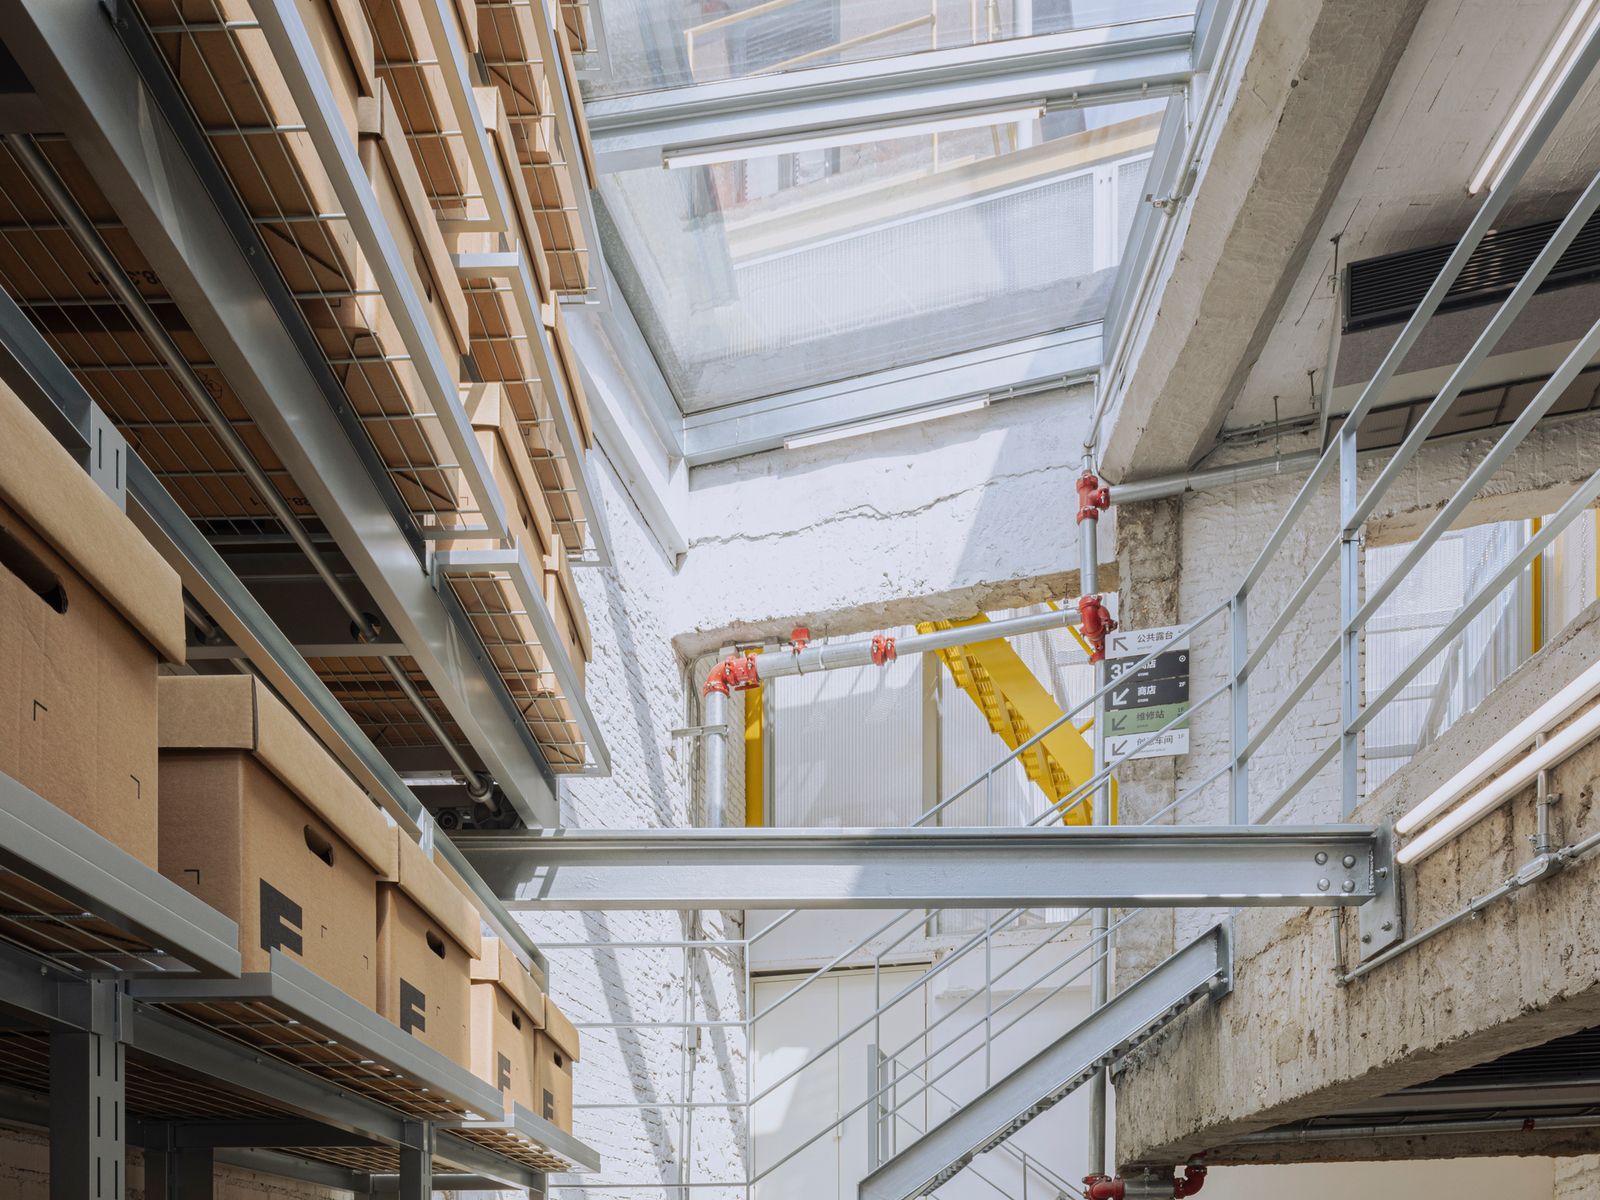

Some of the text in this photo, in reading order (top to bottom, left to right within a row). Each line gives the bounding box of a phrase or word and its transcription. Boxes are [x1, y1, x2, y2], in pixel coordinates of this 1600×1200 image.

[1137, 631, 1174, 643] 公共露台
[1110, 662, 1134, 680] 3F
[1137, 685, 1157, 696] 商店
